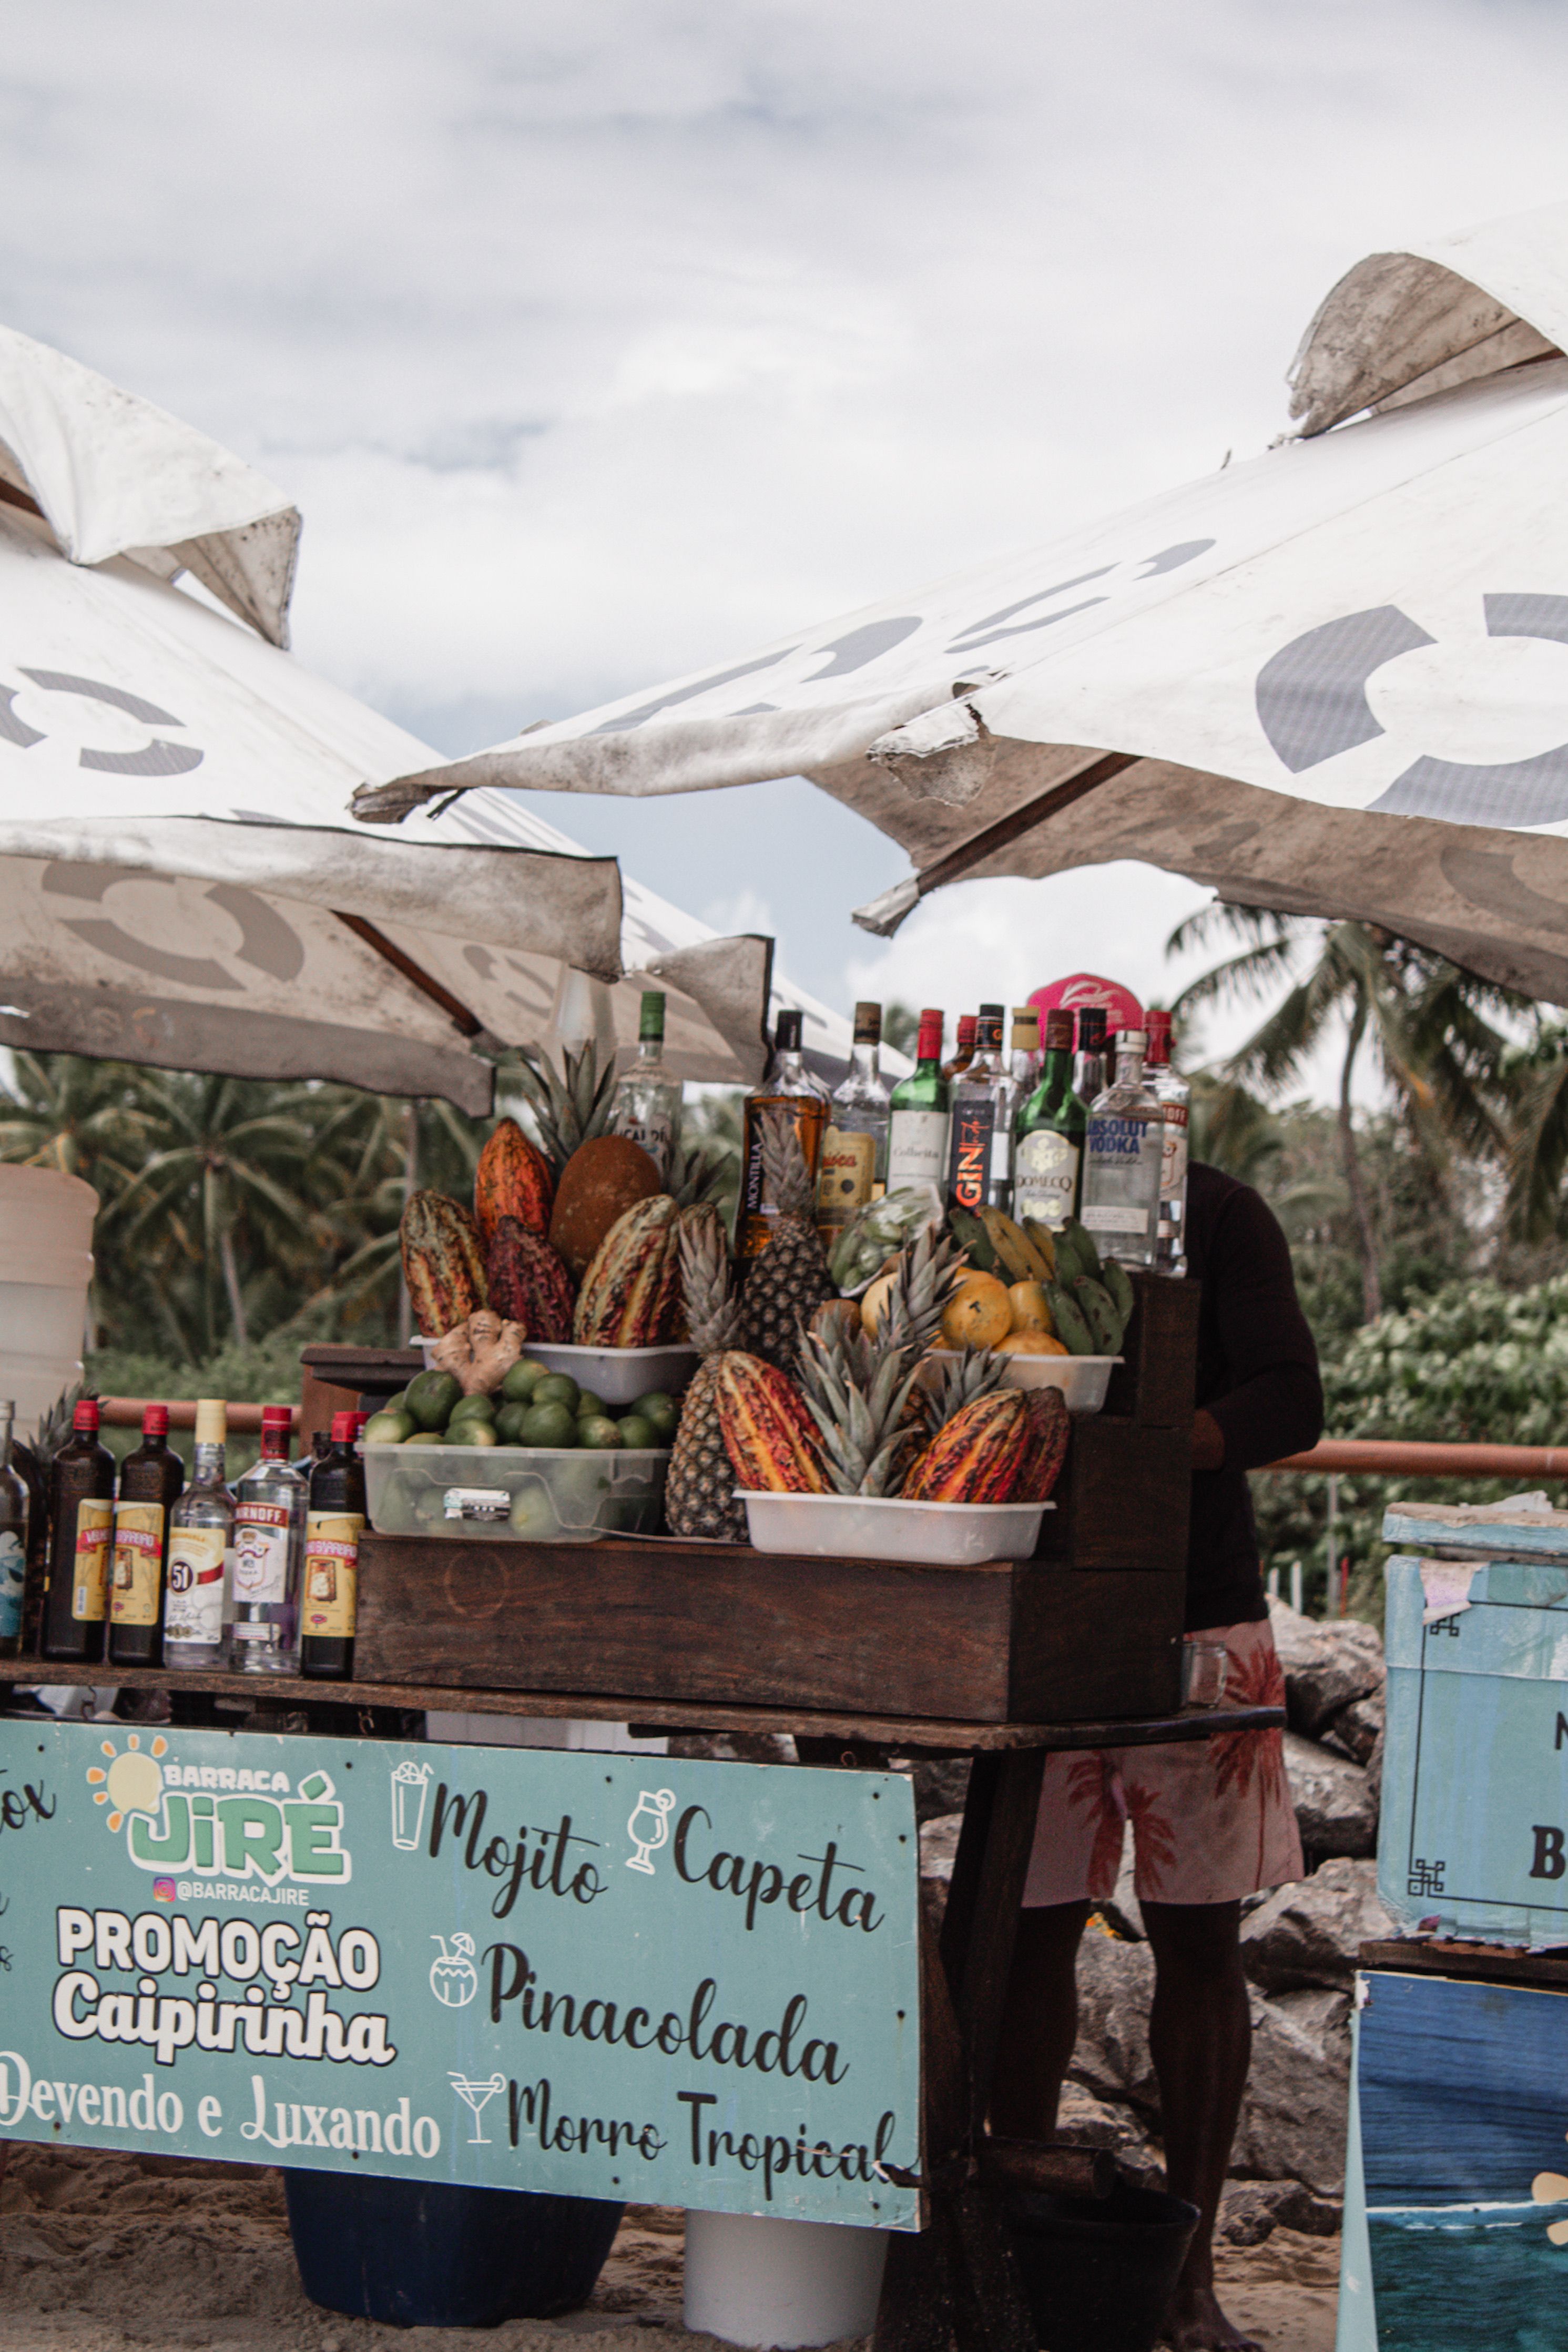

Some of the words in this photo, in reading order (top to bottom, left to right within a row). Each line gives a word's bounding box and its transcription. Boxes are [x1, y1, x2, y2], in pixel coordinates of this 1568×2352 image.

[956, 1146, 984, 1207] GIN
[1089, 1136, 1140, 1154] VODKA
[172, 1565, 190, 1590] 51
[164, 1765, 290, 1793] BARRACA
[177, 1880, 309, 1906] @BARRACAJIRE
[429, 1782, 608, 1919] Mojito
[673, 1804, 885, 1931] Capeta
[57, 1907, 380, 2001] PROMOÇÃO
[52, 1971, 398, 2066] Caipirinha
[481, 1942, 850, 2085] Pinacolada
[197, 2095, 223, 2137] e
[240, 2074, 441, 2158] Luxando
[508, 2078, 668, 2160] Morro
[677, 2091, 920, 2202] Tropical
